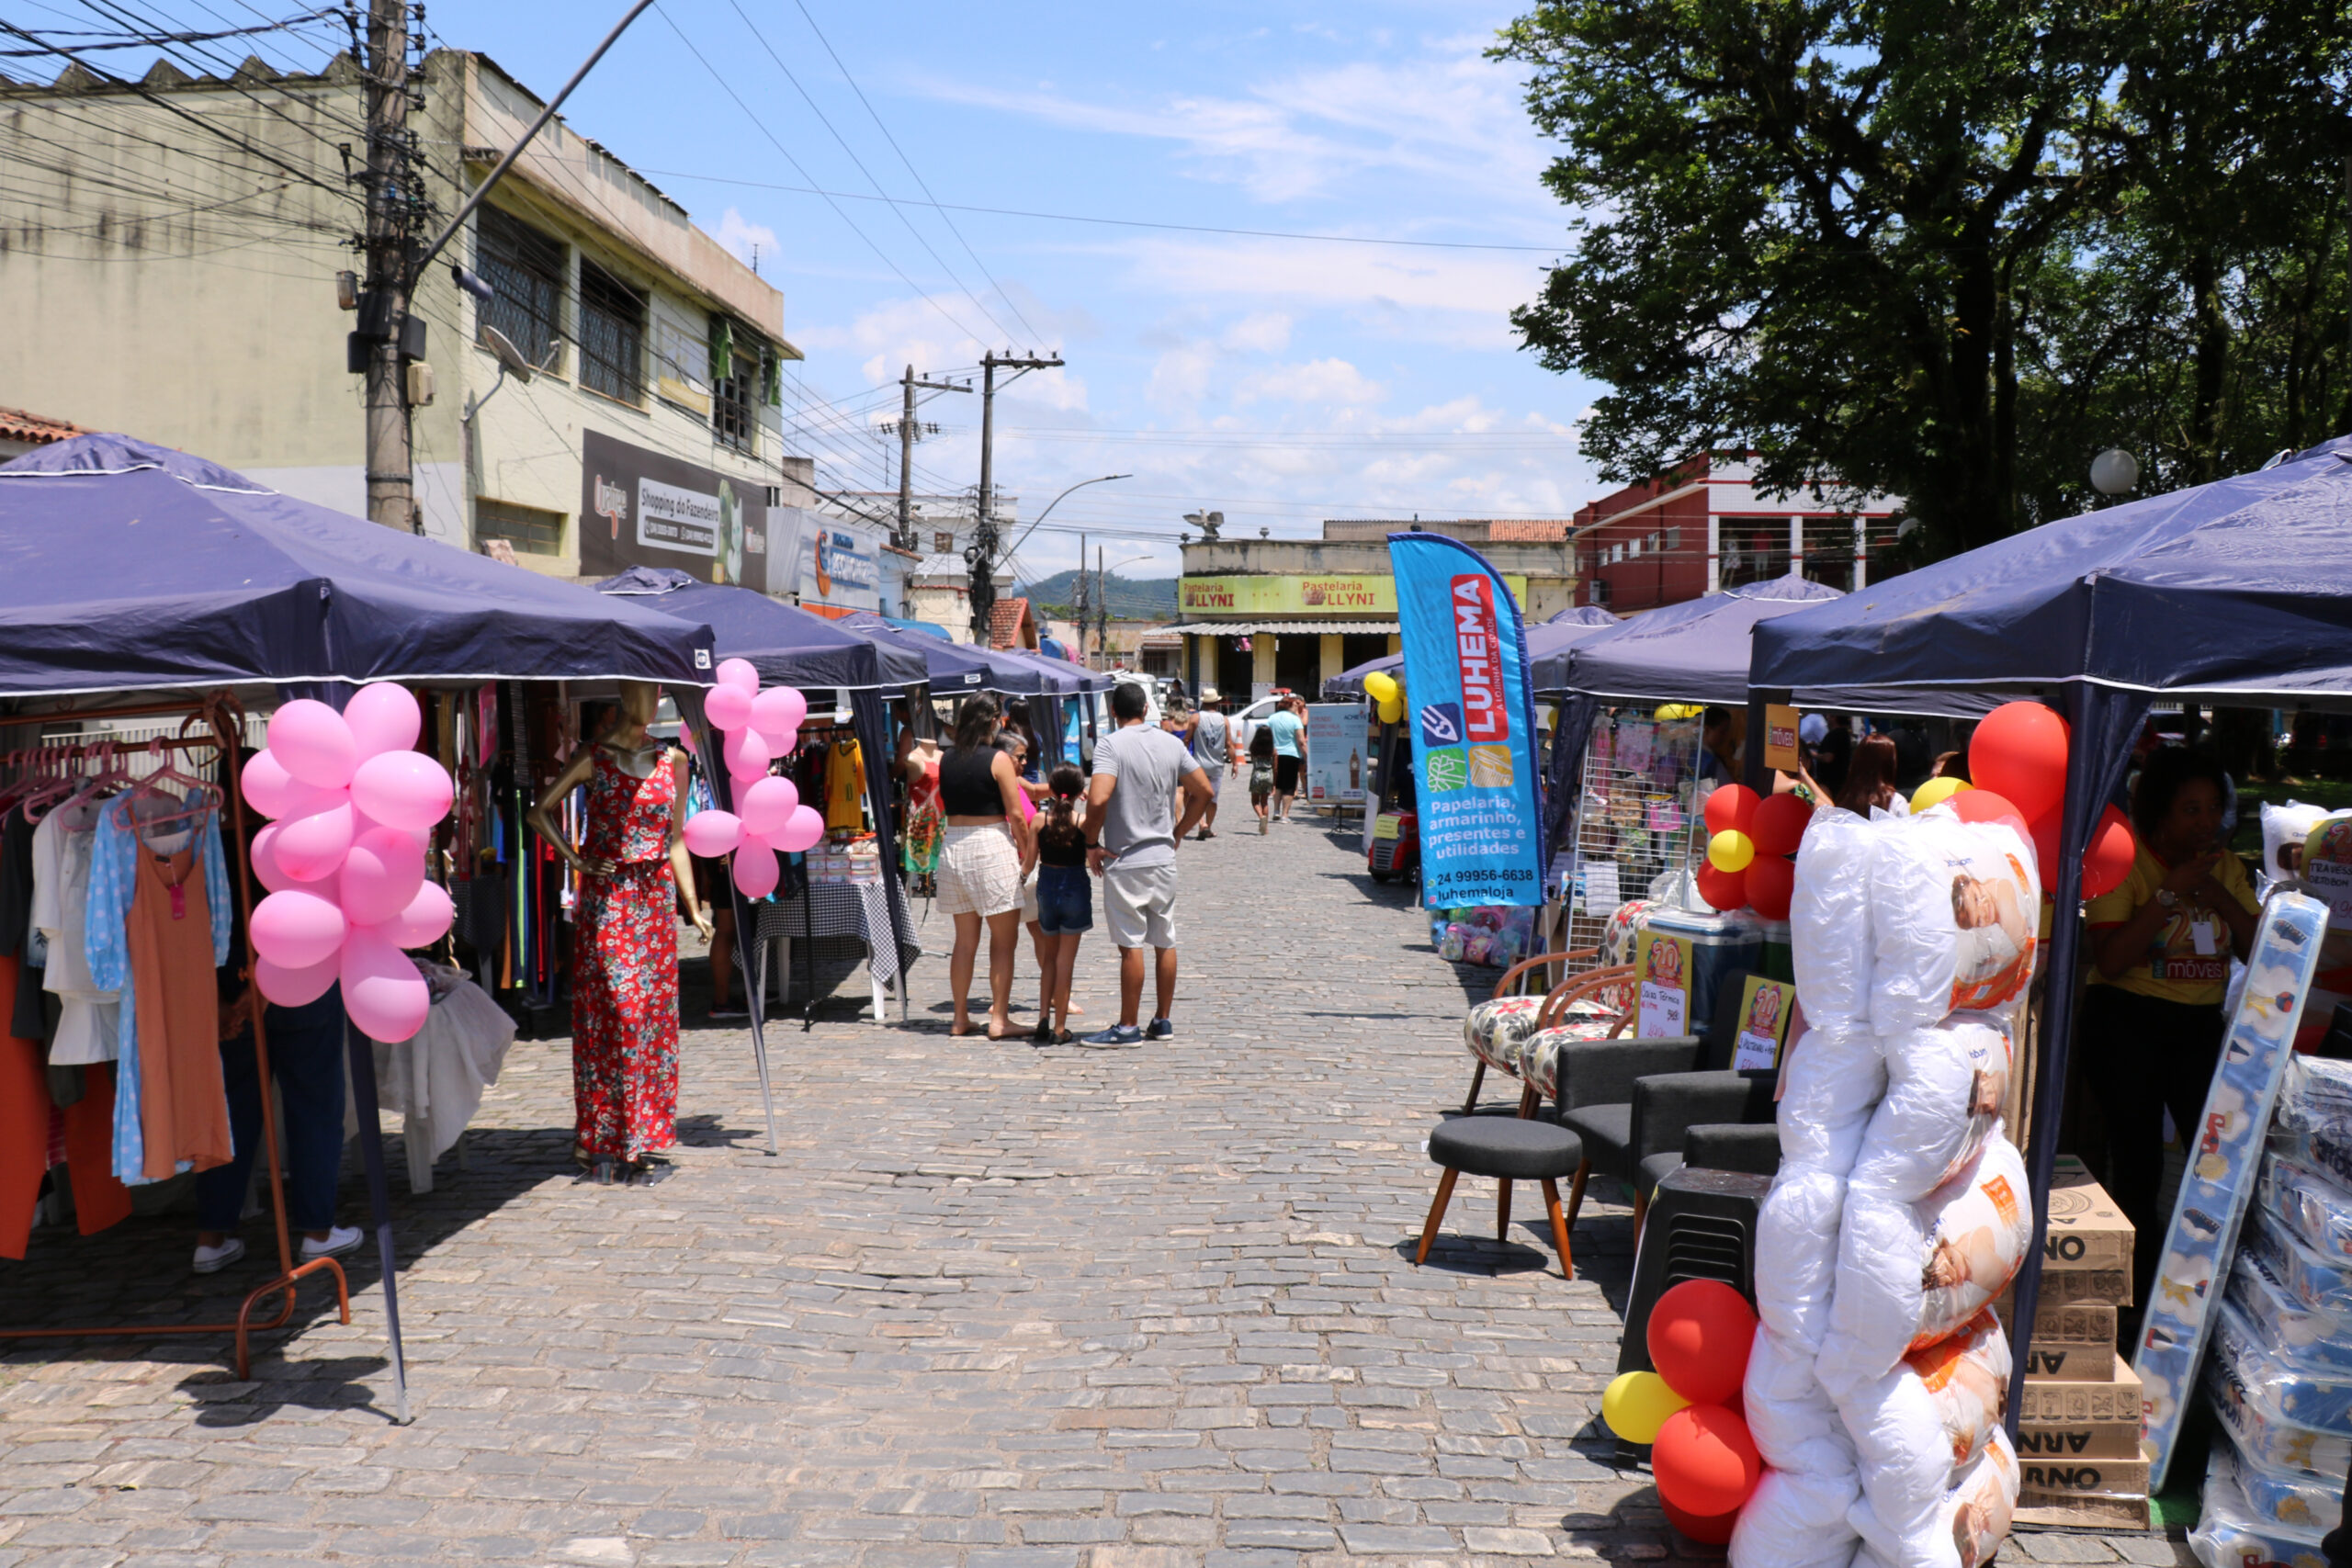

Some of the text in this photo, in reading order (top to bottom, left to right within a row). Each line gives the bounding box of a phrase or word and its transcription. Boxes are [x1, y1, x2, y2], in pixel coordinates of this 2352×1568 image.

[642, 488, 718, 522] Shopping do Fazendeiro
[1183, 582, 1224, 592] Pastelaria
[1303, 581, 1363, 592] Pastelaria
[1453, 579, 1496, 733] LUHEMA
[1487, 616, 1504, 711] A LOJINHA DA CIDADE
[1430, 795, 1516, 814] Papelaria,
[1430, 811, 1521, 830] armarinho,
[1429, 828, 1526, 849] presentes e
[1436, 841, 1520, 859] utilidades
[1437, 870, 1533, 886] 24 99956-6638
[2310, 863, 2352, 875] TRAVESS
[1438, 886, 1514, 901] luhemaloja
[2042, 1235, 2086, 1261] NO
[2017, 1431, 2092, 1453] ARN
[2022, 1467, 2101, 1490] RNO
